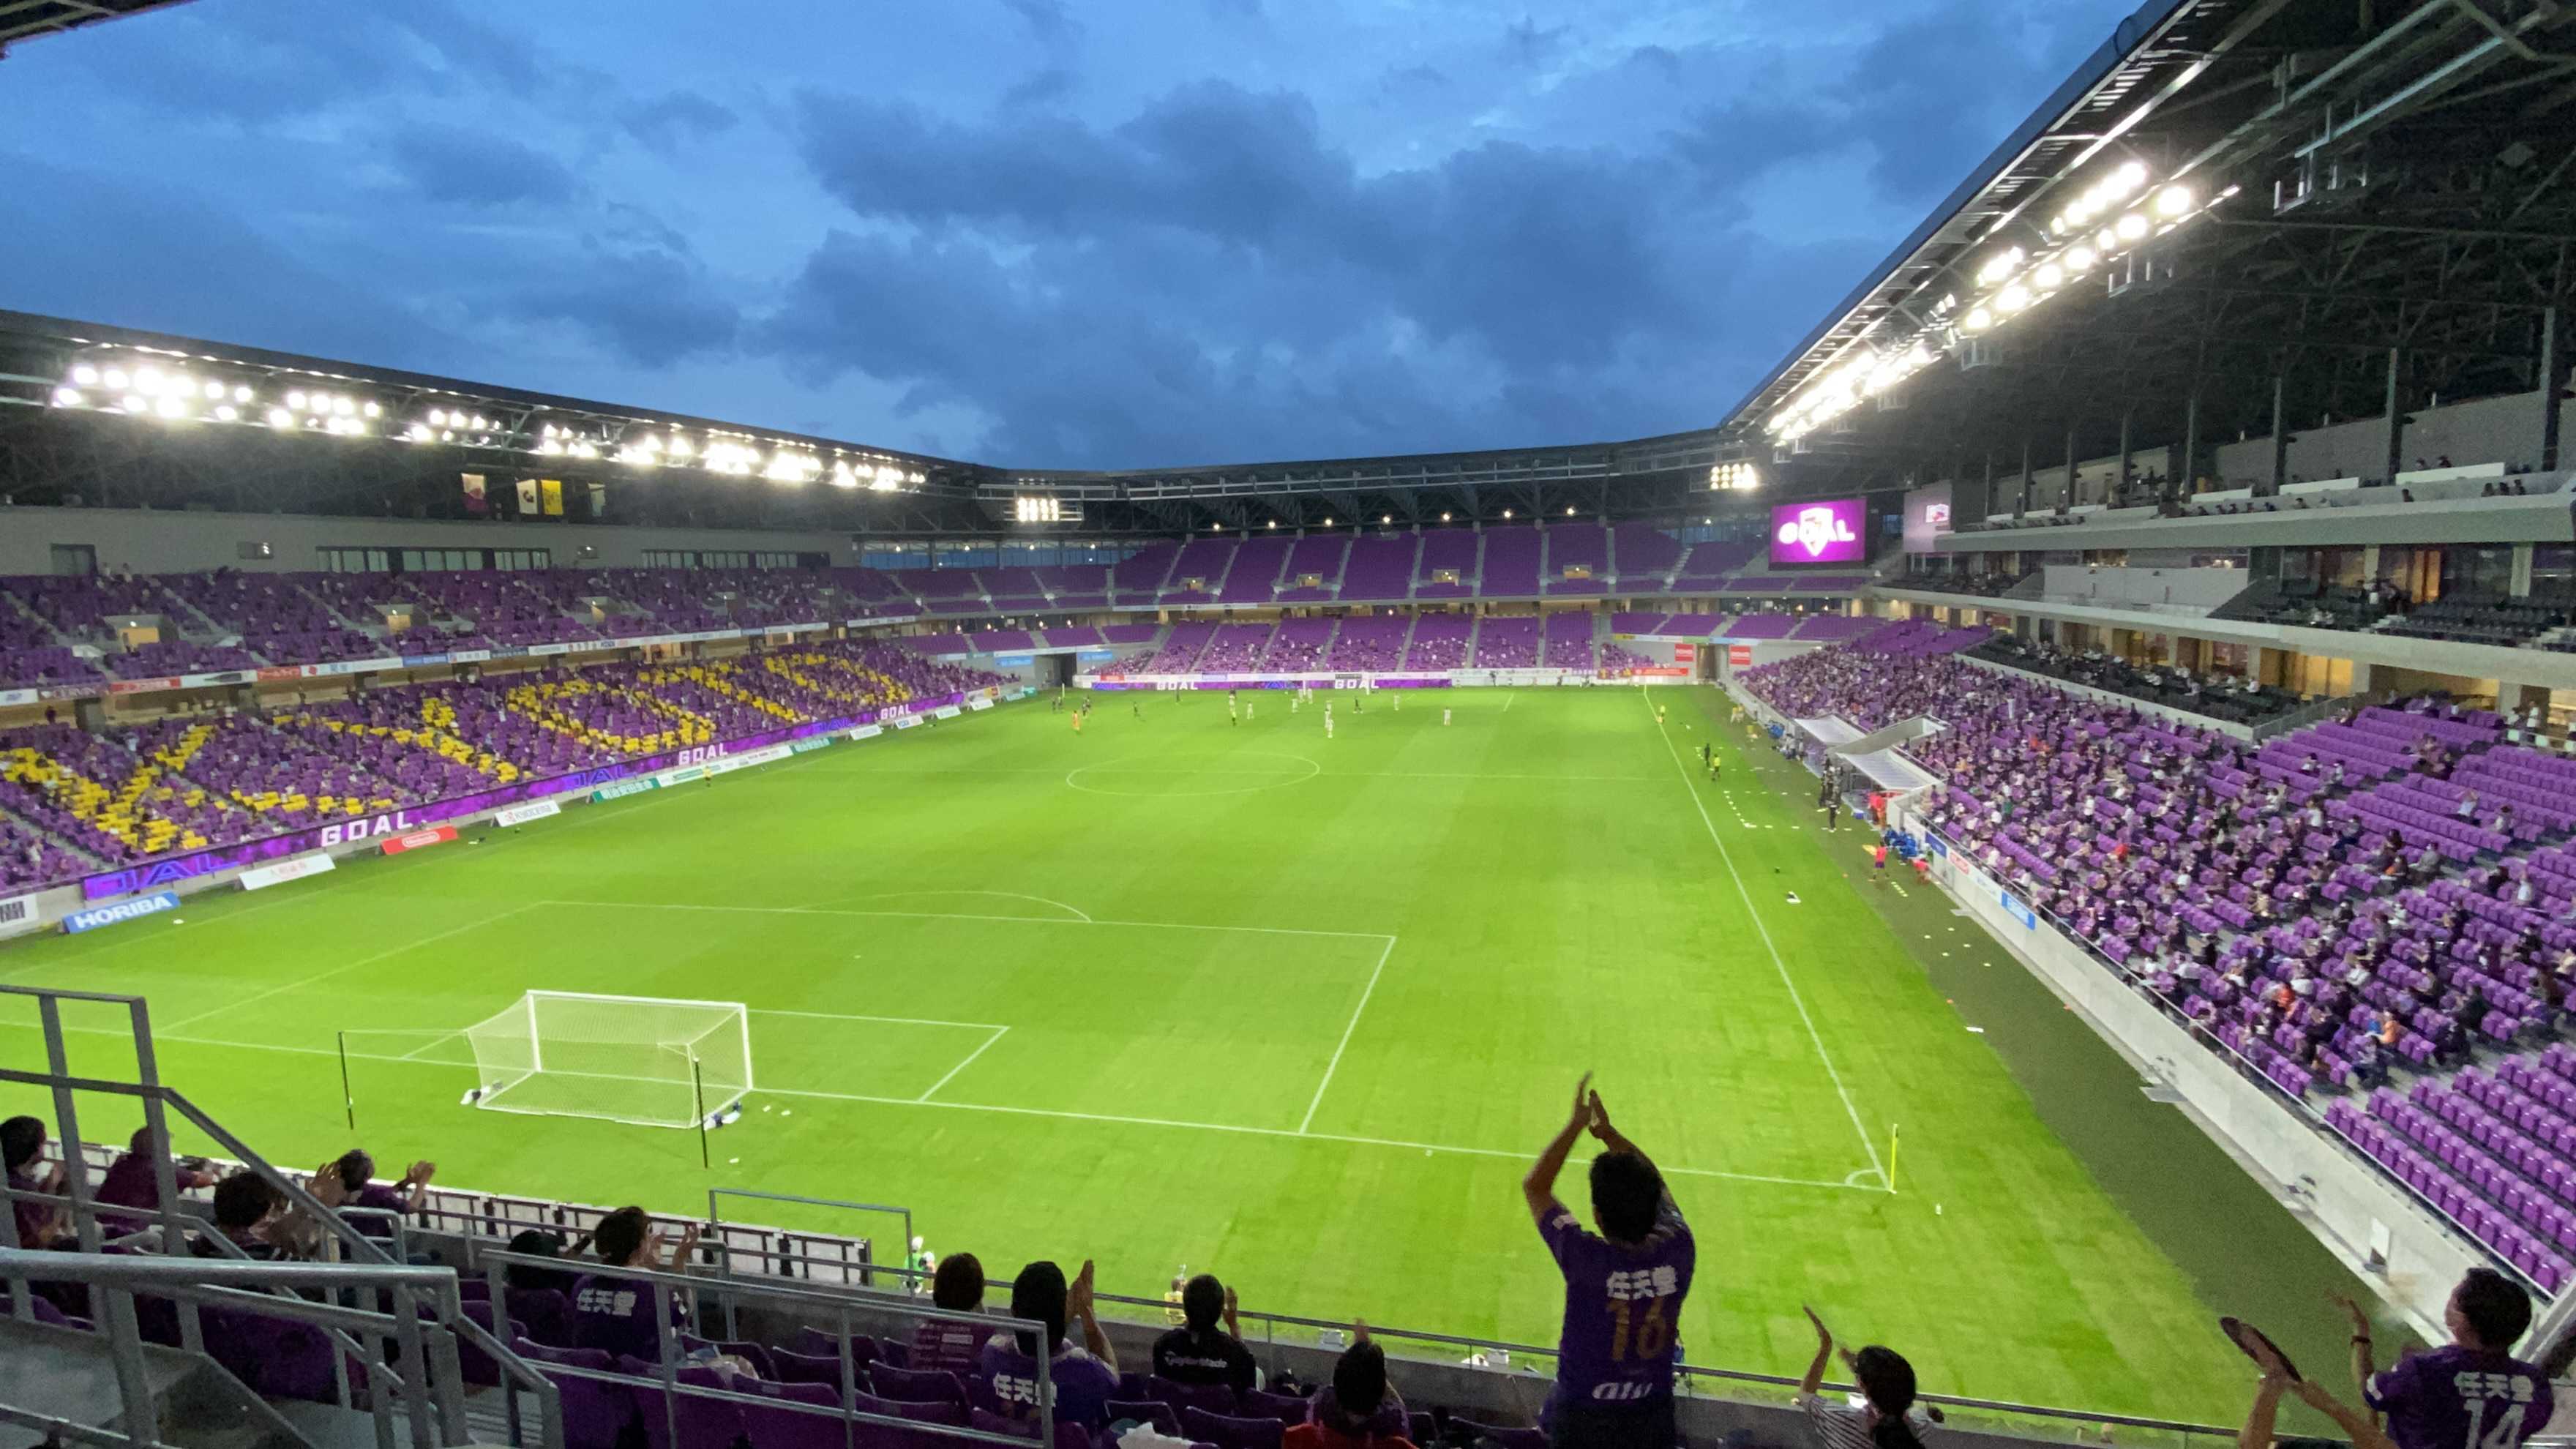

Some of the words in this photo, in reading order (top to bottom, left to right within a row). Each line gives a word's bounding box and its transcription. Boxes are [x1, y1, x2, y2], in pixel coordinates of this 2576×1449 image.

[1156, 681, 1198, 690] GOAL
[1335, 679, 1379, 689] GOAL
[880, 703, 911, 721] GOAL
[678, 742, 728, 766] GOAL
[321, 812, 413, 847] GOAL
[75, 894, 173, 930] HORIBA
[1607, 1298, 1667, 1361] 16
[2463, 1399, 2525, 1449] 14
